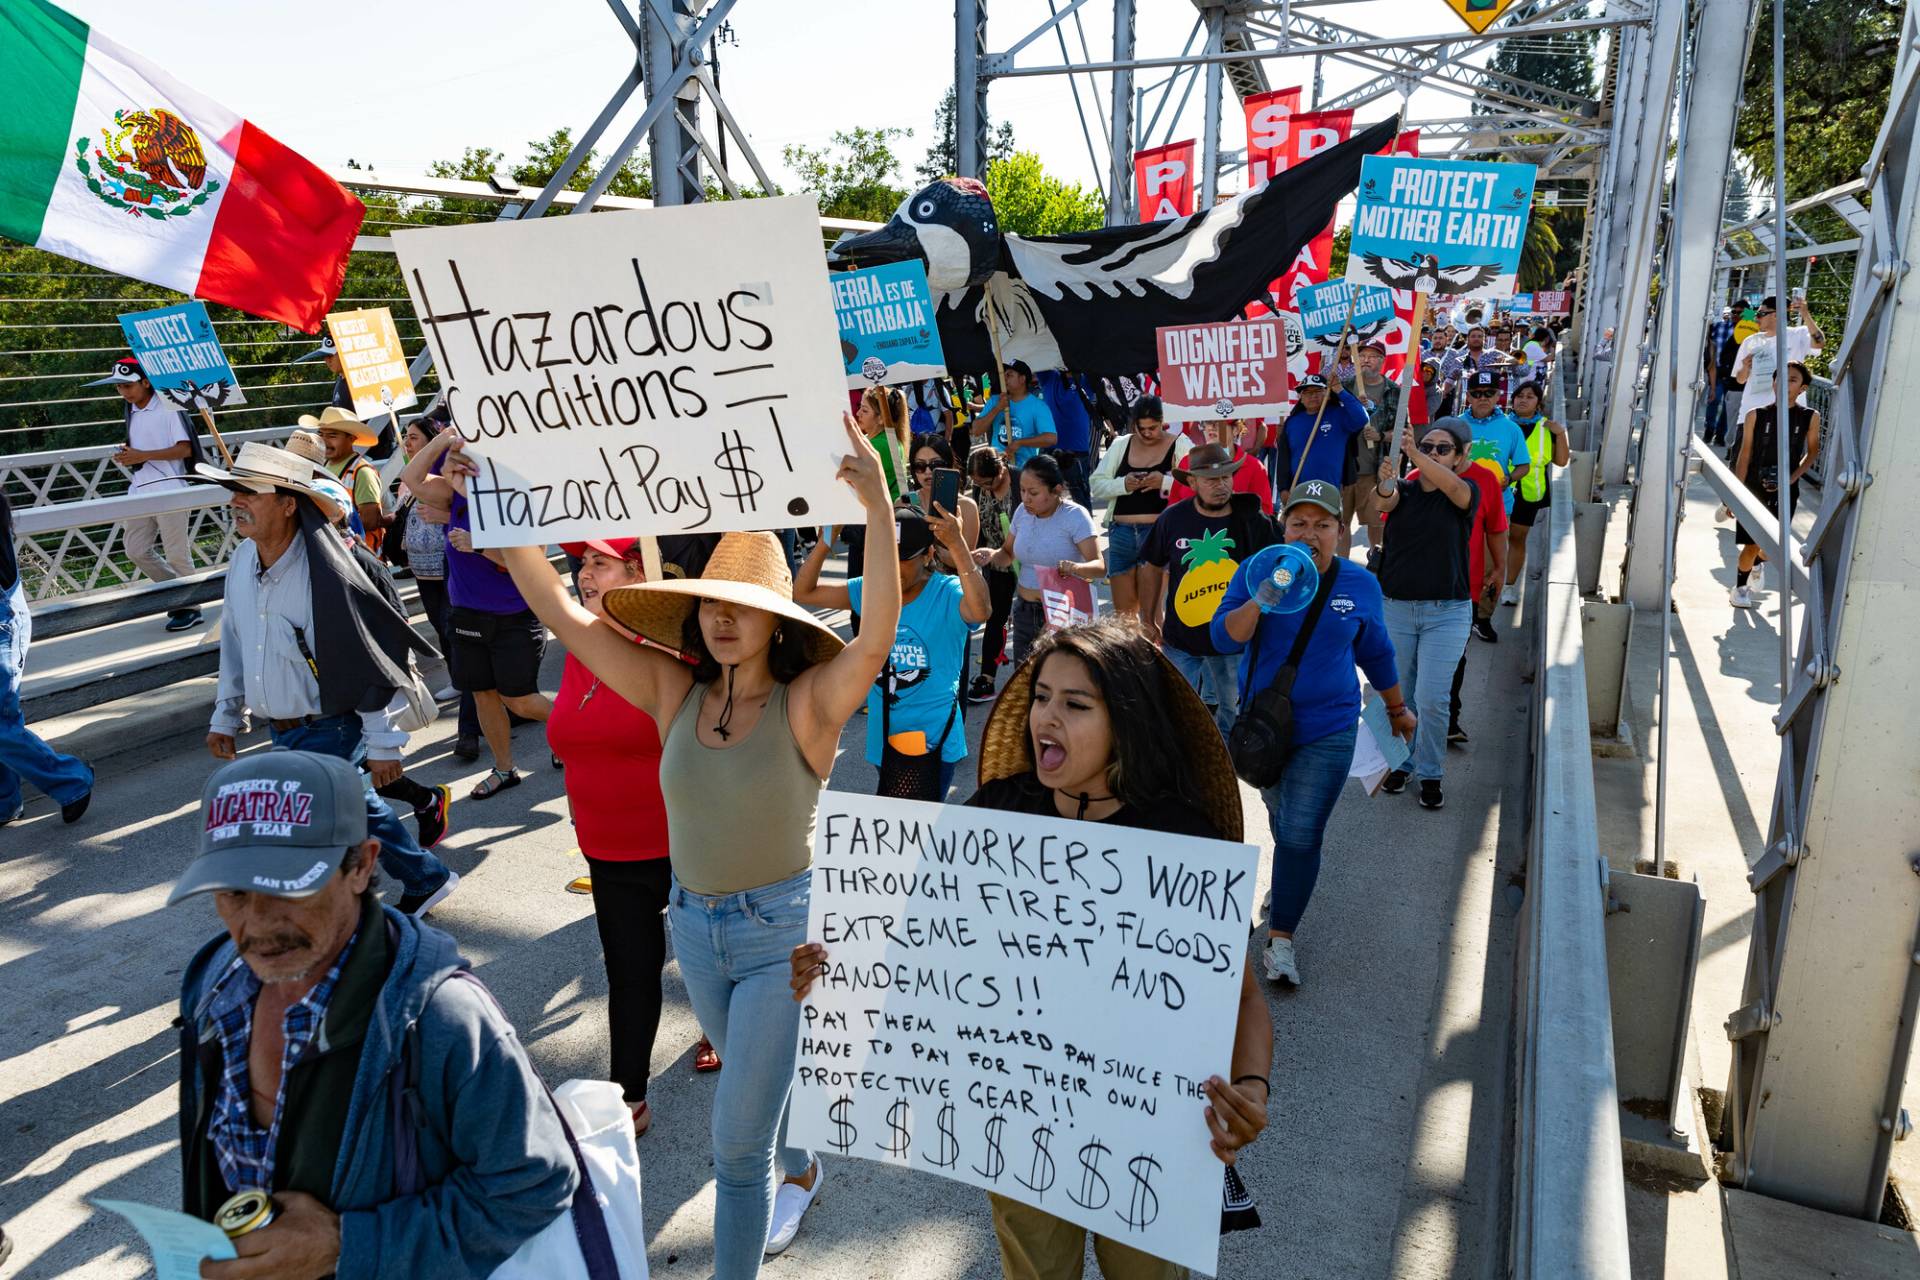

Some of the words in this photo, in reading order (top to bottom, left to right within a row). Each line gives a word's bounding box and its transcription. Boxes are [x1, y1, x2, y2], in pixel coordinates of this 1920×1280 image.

[1389, 167, 1499, 210] PROTECT
[1357, 204, 1442, 244] MOTHER
[1444, 212, 1521, 249] EARTH
[831, 274, 884, 310] IERRA
[885, 282, 901, 302] ES
[901, 280, 916, 299] DE
[1303, 302, 1350, 330] MOTHER
[1354, 291, 1390, 317] EARTH
[134, 312, 194, 349] PROTECT
[413, 258, 773, 381] Hazardous
[840, 312, 855, 330] LA
[137, 347, 186, 377] MOTHER
[178, 340, 224, 371] EARTH
[1164, 323, 1277, 366] DIGNIFIED
[1180, 360, 1266, 400] WAGES
[471, 447, 630, 531] Hazard
[619, 445, 712, 530] Pay
[894, 644, 923, 654] WITH
[217, 778, 279, 798] PROPERTY
[282, 780, 301, 793] OF
[205, 791, 314, 833] ALCATRAZ
[212, 823, 240, 842] SWIM
[252, 823, 293, 838] TEAM
[818, 866, 960, 903] THROUGH
[825, 813, 1123, 896] FARMWORKERS
[1146, 855, 1247, 924] WORK
[822, 912, 977, 949] EXTREME
[998, 931, 1095, 968] HEAT
[1111, 957, 1186, 1010] AND
[804, 1005, 847, 1032] PAY
[864, 1010, 936, 1033] THEM
[957, 1025, 1053, 1052] HAZARD
[1064, 1043, 1096, 1072] PAY
[1103, 1059, 1162, 1087] SINCE
[1173, 1074, 1206, 1100] THE
[799, 1066, 950, 1098] PROTECTIVE
[801, 1037, 853, 1059] HAVE
[870, 1039, 893, 1056] TO
[912, 1042, 949, 1066] PAY
[968, 1052, 1011, 1076] FOR
[1023, 1064, 1092, 1098] THEIR
[1108, 1087, 1157, 1117] OWN
